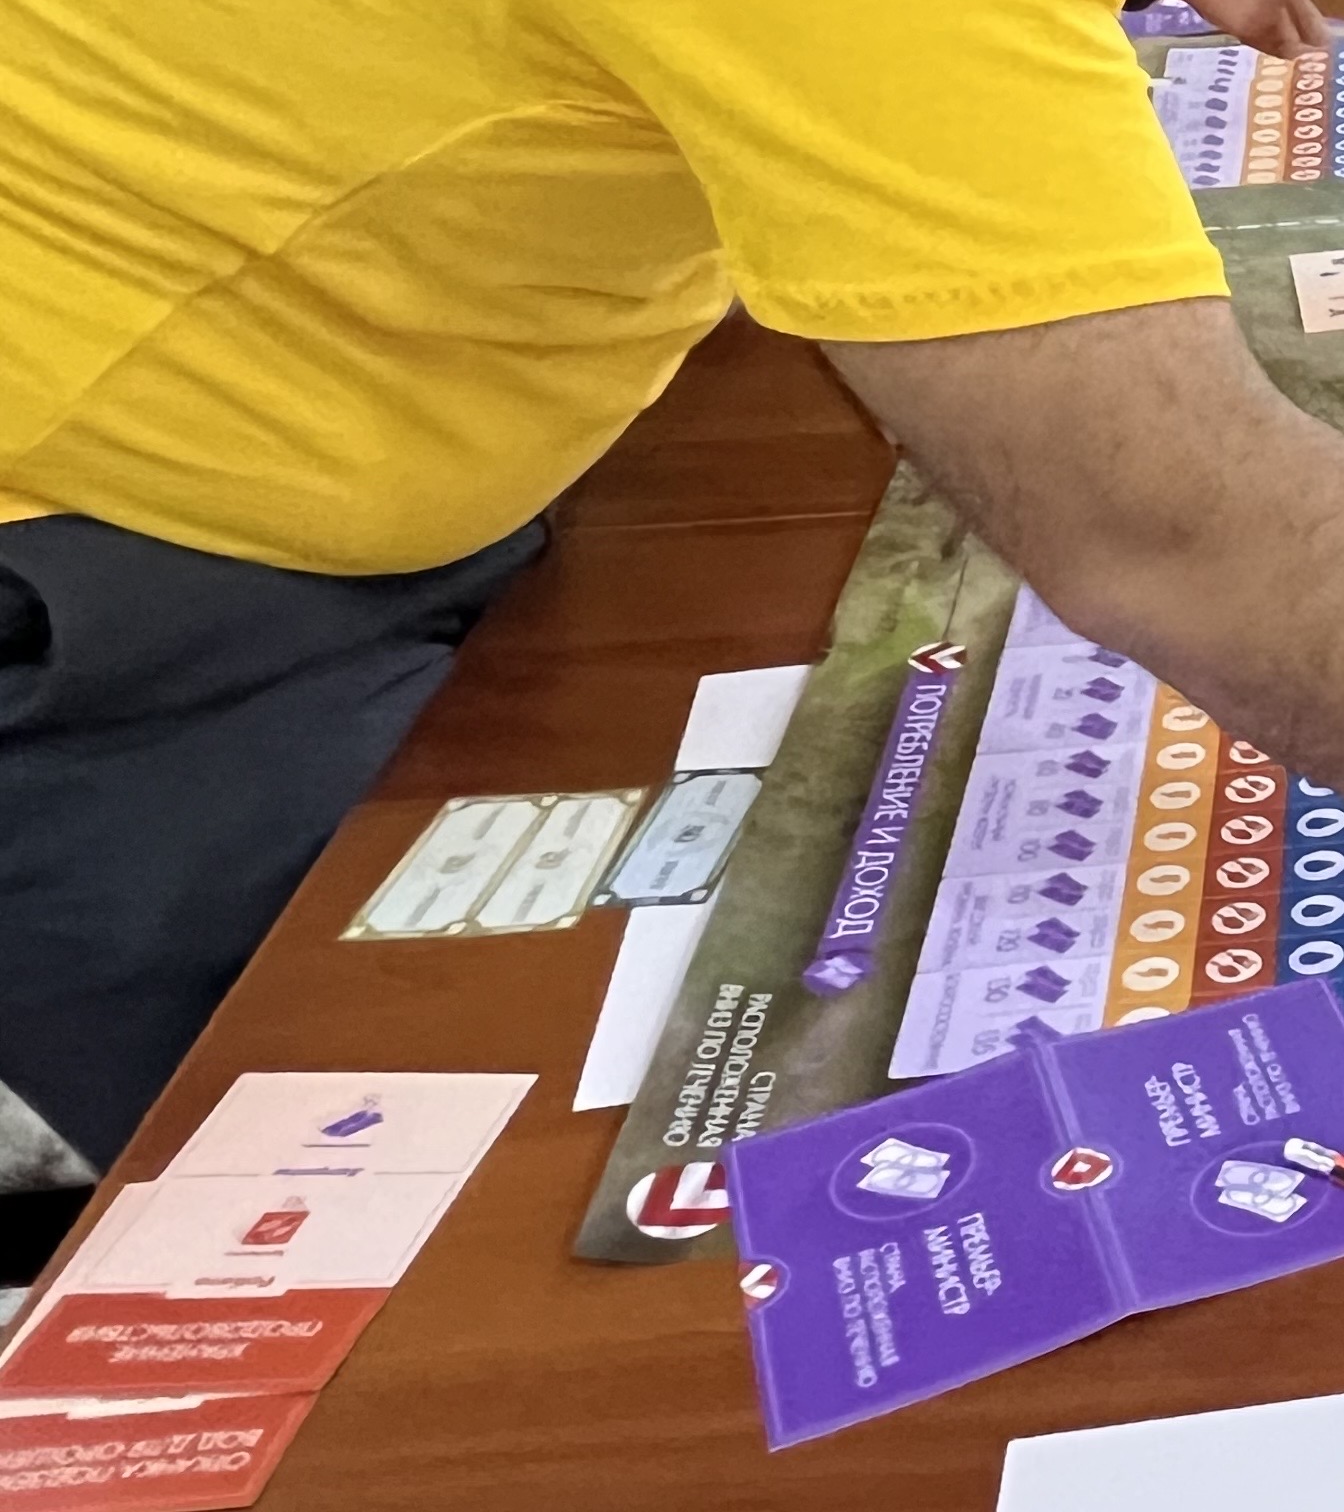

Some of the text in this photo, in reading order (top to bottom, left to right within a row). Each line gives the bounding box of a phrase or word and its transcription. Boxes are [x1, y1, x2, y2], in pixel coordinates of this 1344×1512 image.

[829, 684, 947, 939] ПОТРЕБЛЕНИЕ И ДОХОД
[697, 1030, 727, 1059] ПО
